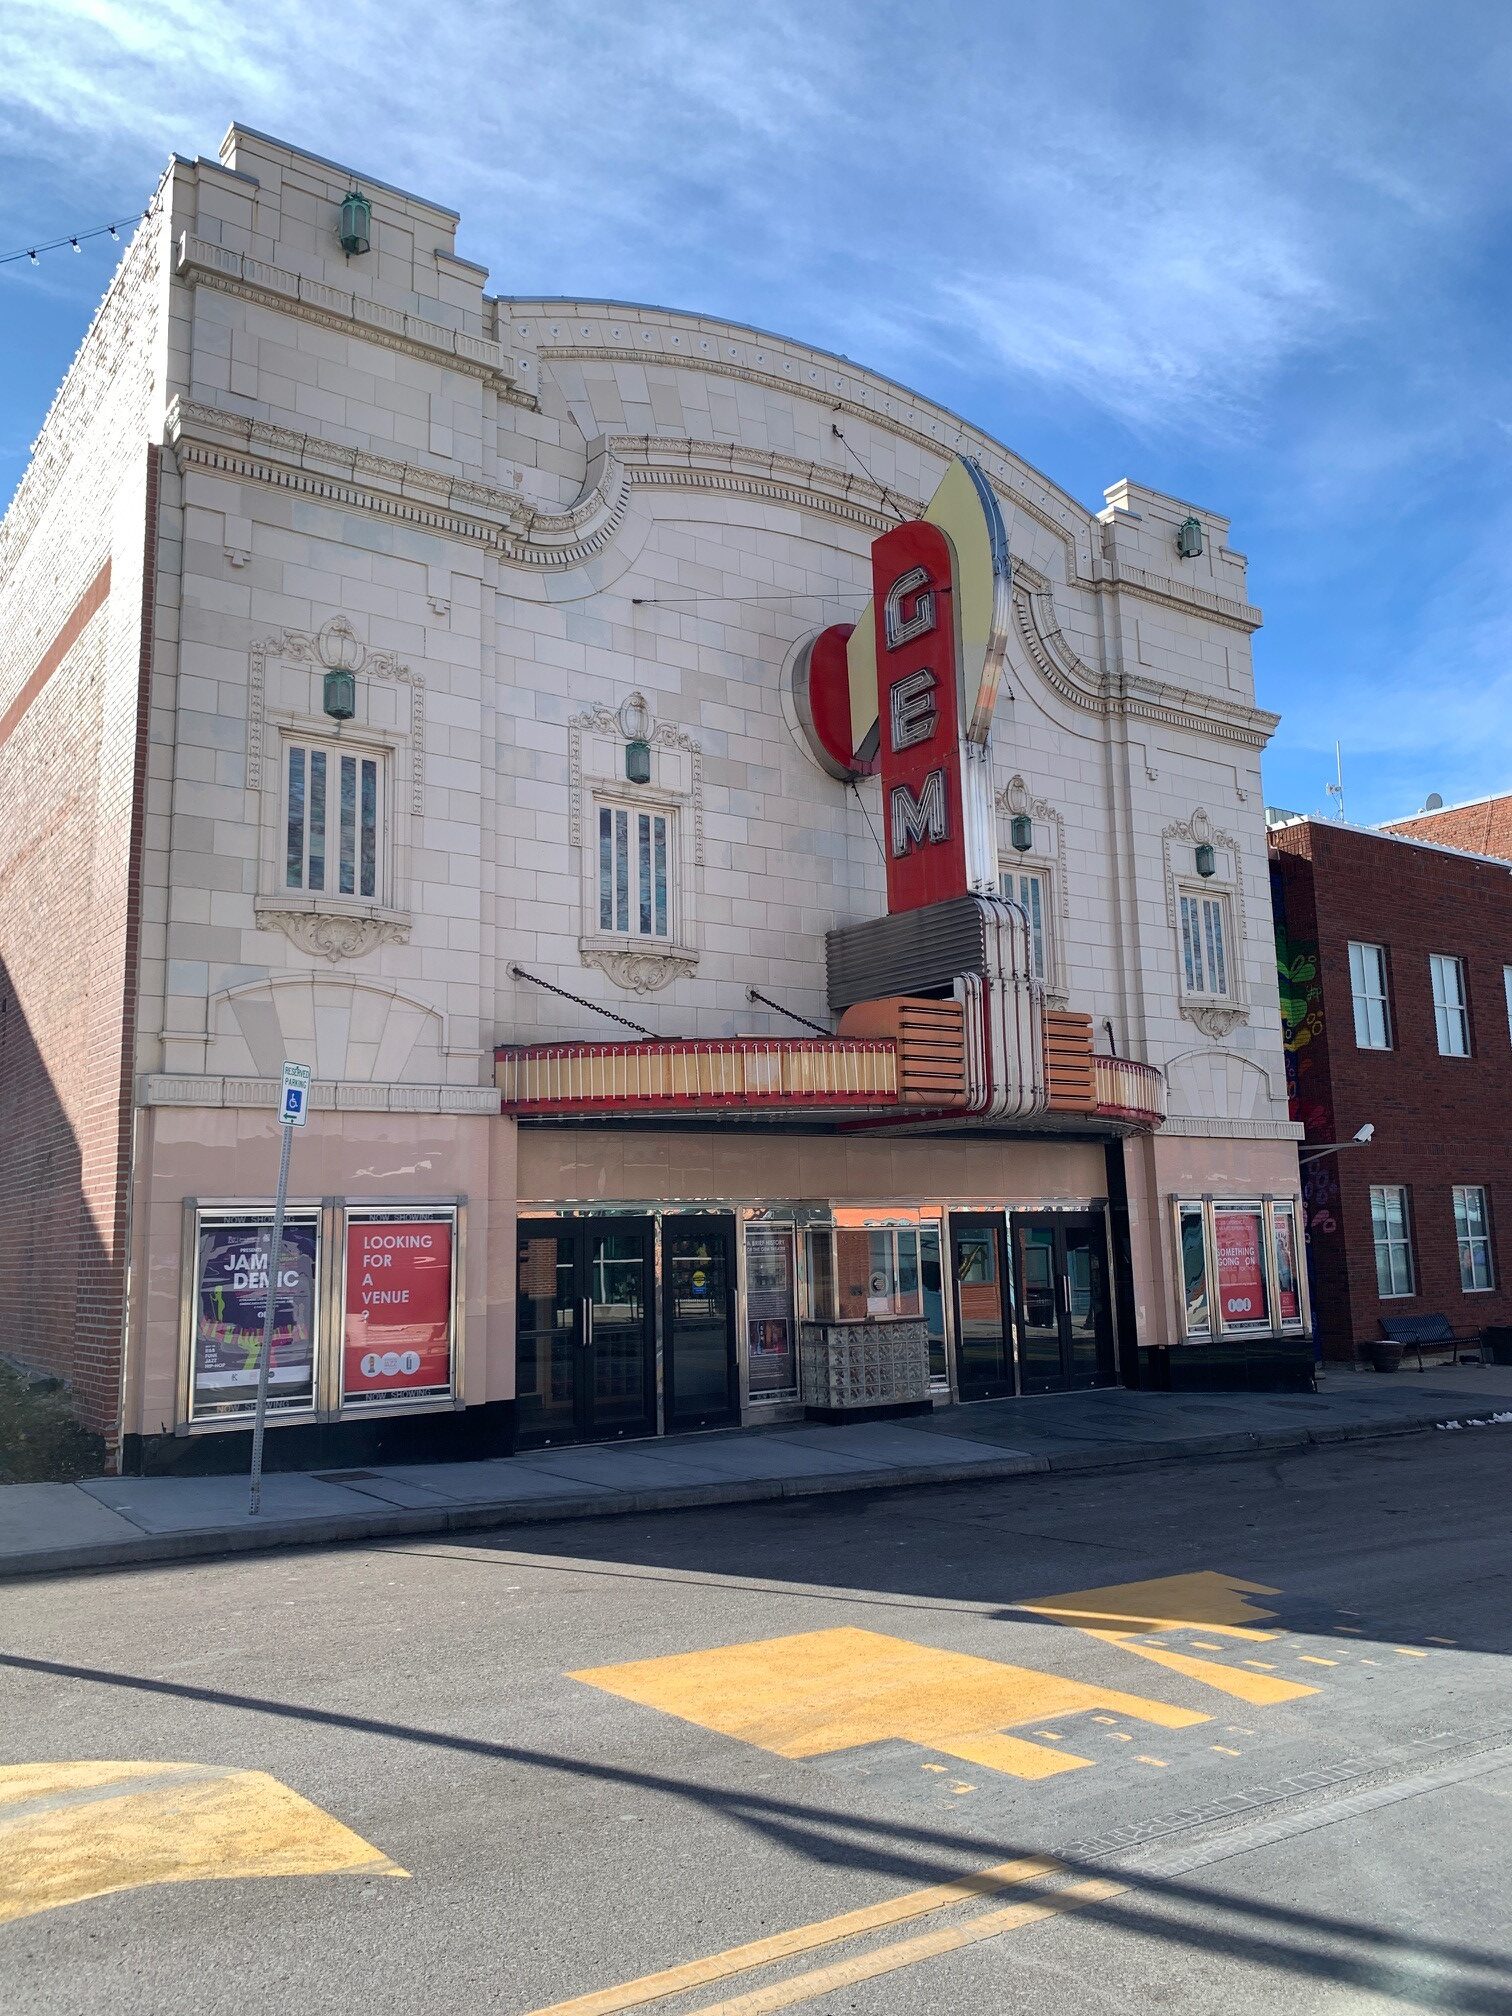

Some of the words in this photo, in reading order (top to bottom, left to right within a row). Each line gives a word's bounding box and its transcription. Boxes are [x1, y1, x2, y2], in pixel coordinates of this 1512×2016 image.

[885, 565, 950, 859] GEM
[285, 1066, 309, 1078] RESERVED
[285, 1077, 306, 1088] PARKING
[223, 1216, 246, 1224] NOW
[394, 1213, 434, 1221] SHOWING
[364, 1235, 433, 1250] LOOKING
[1217, 1247, 1255, 1257] SOMETHING
[224, 1253, 268, 1271] JAM
[363, 1254, 392, 1268] FOR
[1218, 1258, 1240, 1267] GOING
[1245, 1257, 1255, 1266] ON
[362, 1273, 373, 1286] A
[362, 1290, 410, 1304] VENUE
[365, 1393, 387, 1401] NOW
[391, 1388, 431, 1399] SHOWING
[215, 1403, 240, 1413] NOW
